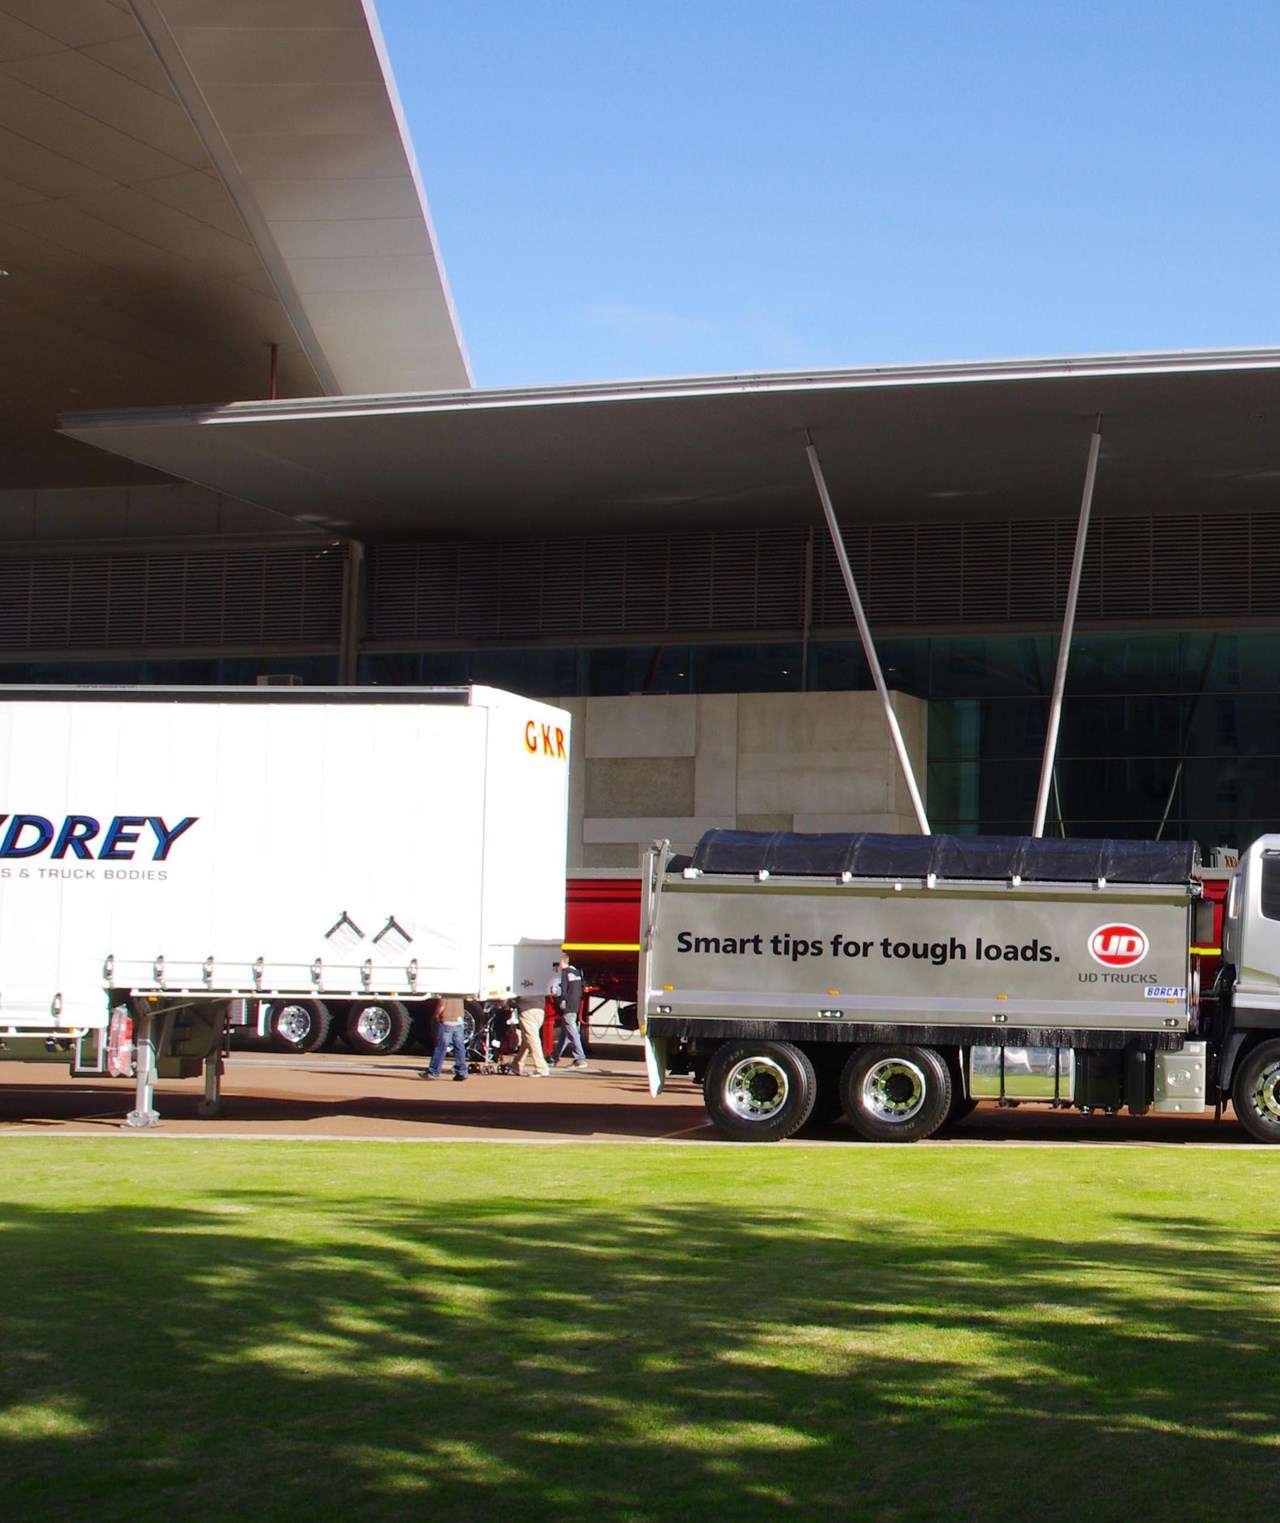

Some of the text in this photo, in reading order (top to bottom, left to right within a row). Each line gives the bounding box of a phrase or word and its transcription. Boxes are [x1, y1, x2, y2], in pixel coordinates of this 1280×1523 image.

[0, 814, 200, 861] DREY
[19, 868, 30, 878] &
[38, 868, 96, 879] TRUCK
[104, 869, 168, 881] BODIES
[677, 931, 1061, 966] Smart tips for tough loads.
[1093, 935, 1145, 956] UD
[1078, 973, 1158, 984] UD TRUCKS
